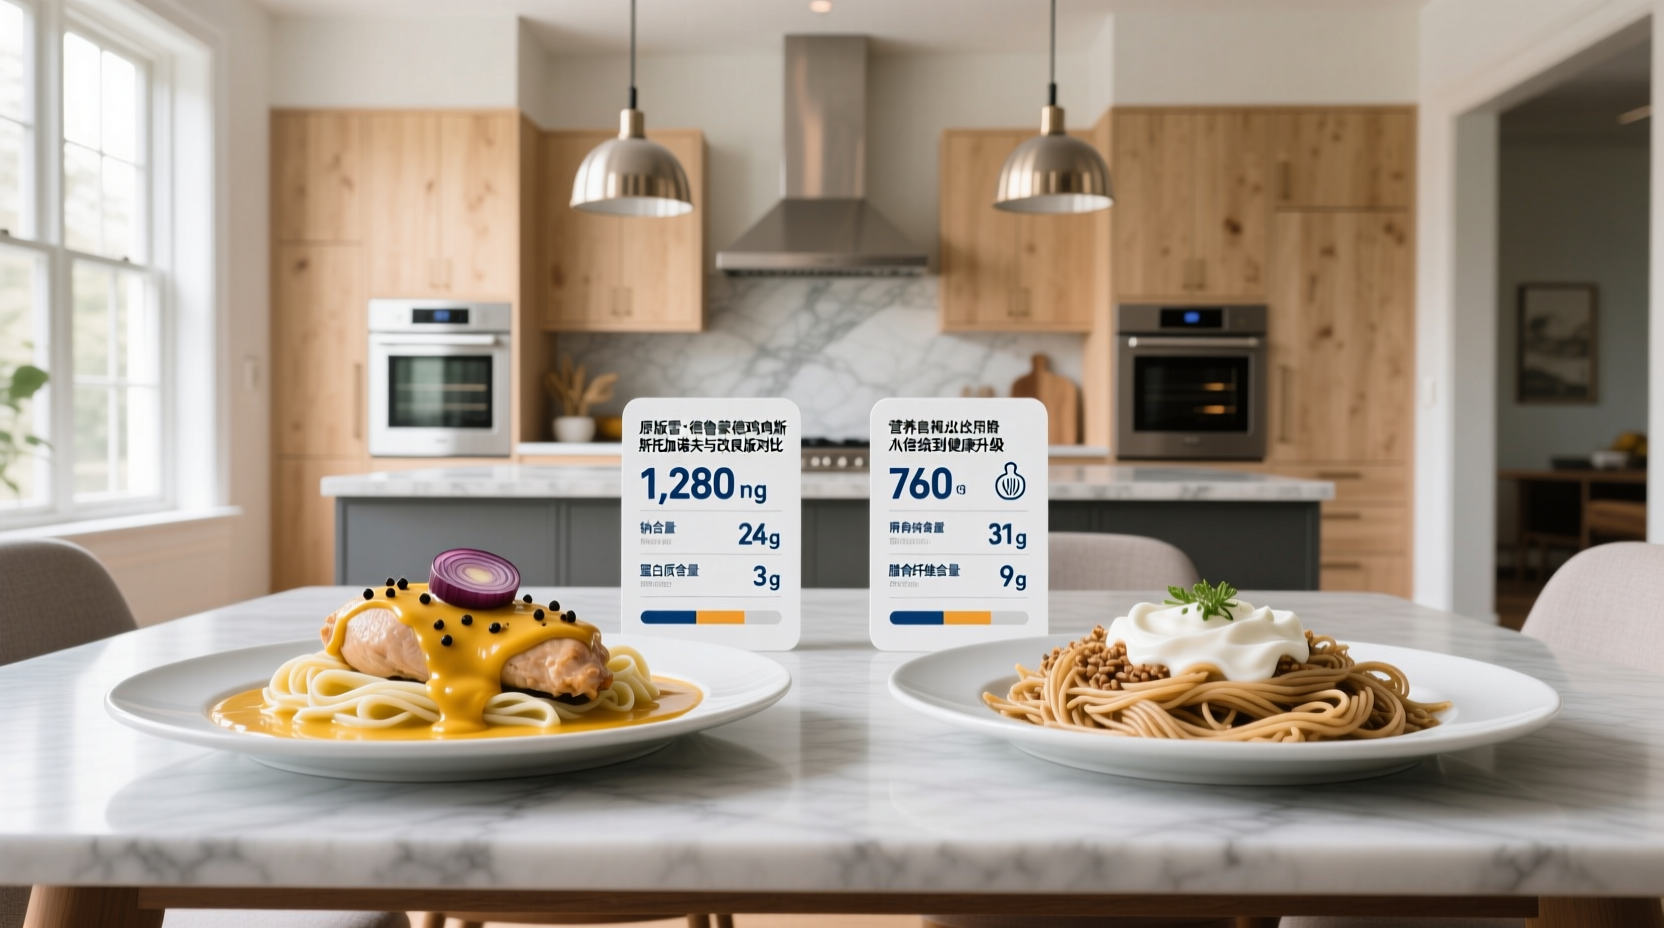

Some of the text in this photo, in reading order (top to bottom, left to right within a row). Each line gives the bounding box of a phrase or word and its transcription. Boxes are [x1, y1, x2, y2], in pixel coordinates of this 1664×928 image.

[641, 466, 767, 505] 1,280 ng
[889, 467, 953, 500] 760
